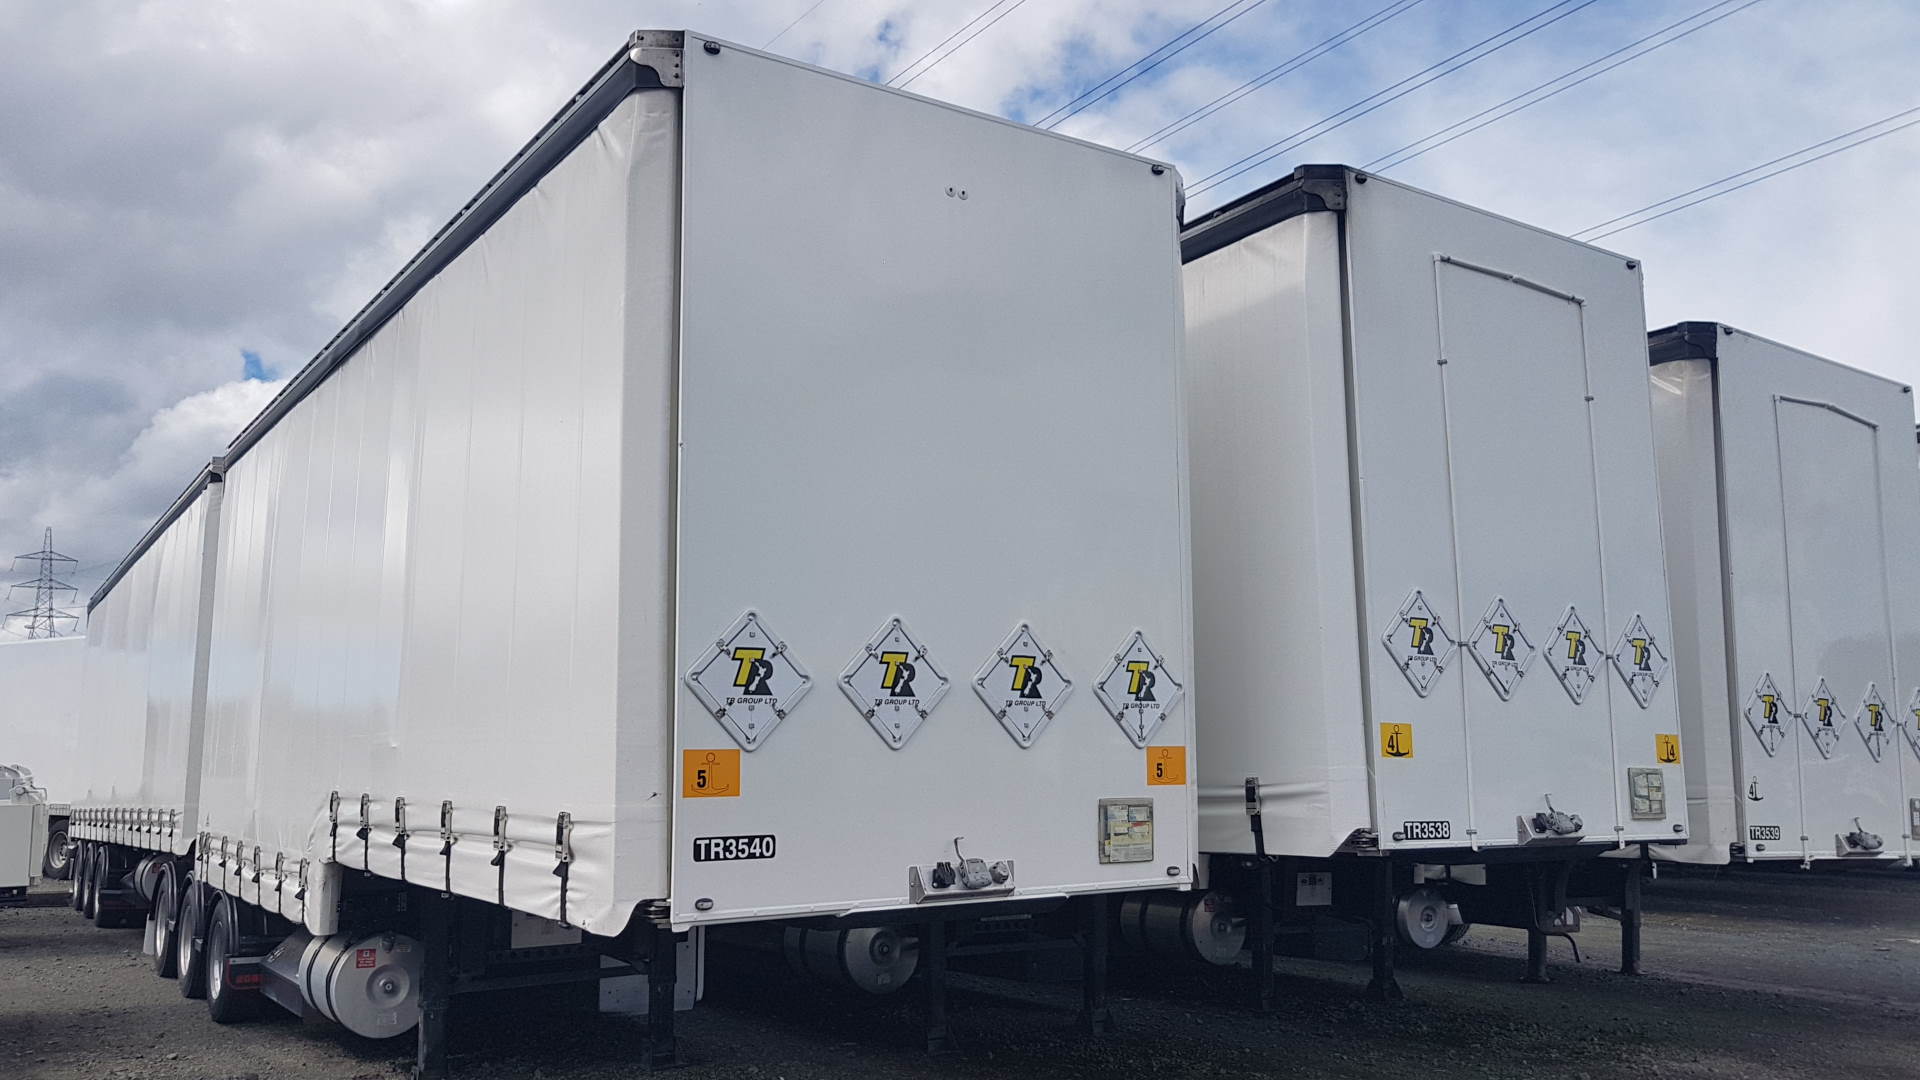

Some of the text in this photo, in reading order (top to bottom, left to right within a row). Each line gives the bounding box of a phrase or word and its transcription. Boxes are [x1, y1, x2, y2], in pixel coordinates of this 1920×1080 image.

[731, 647, 774, 696] TR
[879, 651, 916, 697] TR
[1009, 655, 1043, 699] TR
[1126, 660, 1157, 702] TR
[737, 697, 763, 705] GROUP
[764, 697, 778, 705] LTD
[884, 698, 908, 706] GROUP
[1387, 734, 1395, 752] 4
[1669, 744, 1676, 759] 4
[696, 769, 707, 788] 5
[1156, 762, 1163, 778] 5
[1404, 822, 1450, 839] TR3538
[1750, 826, 1780, 840] TR3539
[696, 837, 774, 860] TR3540
